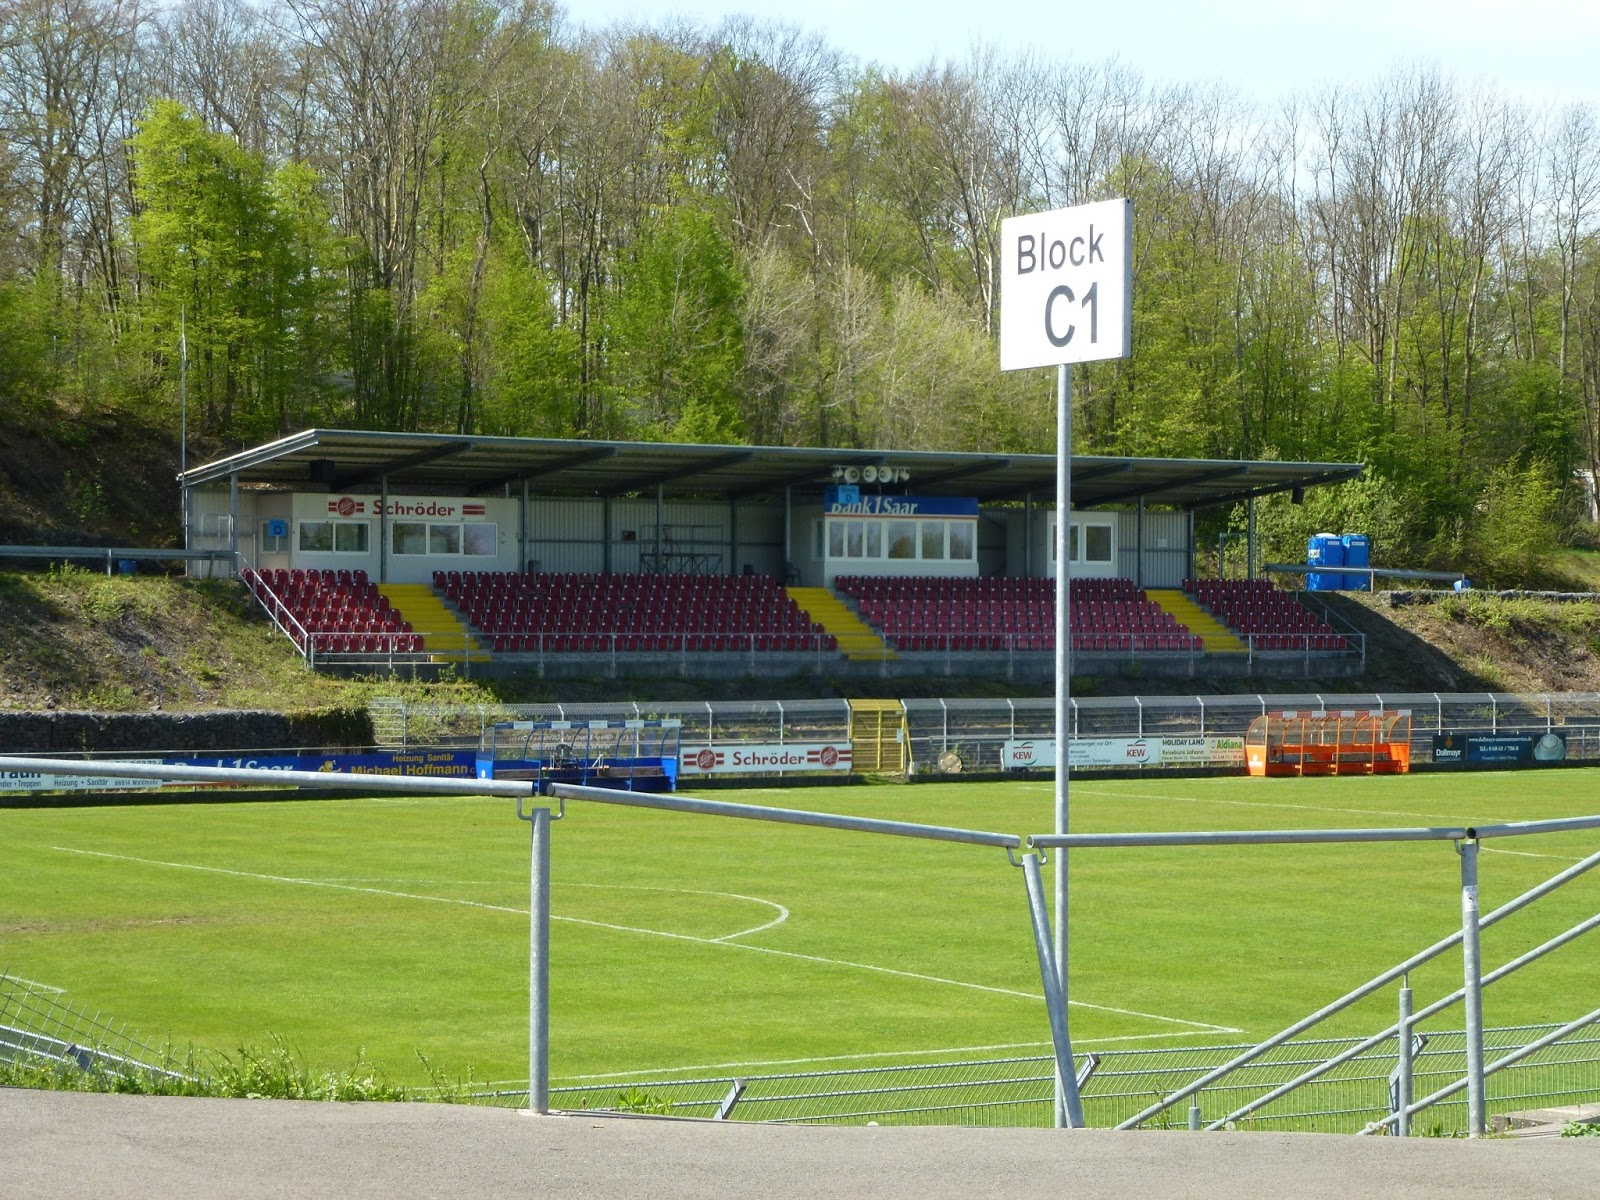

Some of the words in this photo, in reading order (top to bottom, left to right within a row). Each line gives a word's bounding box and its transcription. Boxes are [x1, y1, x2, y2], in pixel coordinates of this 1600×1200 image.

[1017, 223, 1105, 276] Block
[1044, 281, 1098, 348] C1
[372, 500, 456, 517] Schröder
[1216, 739, 1243, 749] Aldiana
[392, 754, 424, 763] Heizung
[427, 753, 455, 762] Sanitär
[1013, 751, 1033, 760] KEW
[1127, 749, 1145, 757] KEW
[1436, 749, 1462, 757] Dallmayr
[732, 751, 805, 766] Schröder
[351, 765, 402, 776] Michael
[406, 763, 468, 776] Hoffmann
[18, 780, 41, 789] Treppen
[54, 779, 78, 788] Heizung
[86, 778, 108, 786] Sanitär
